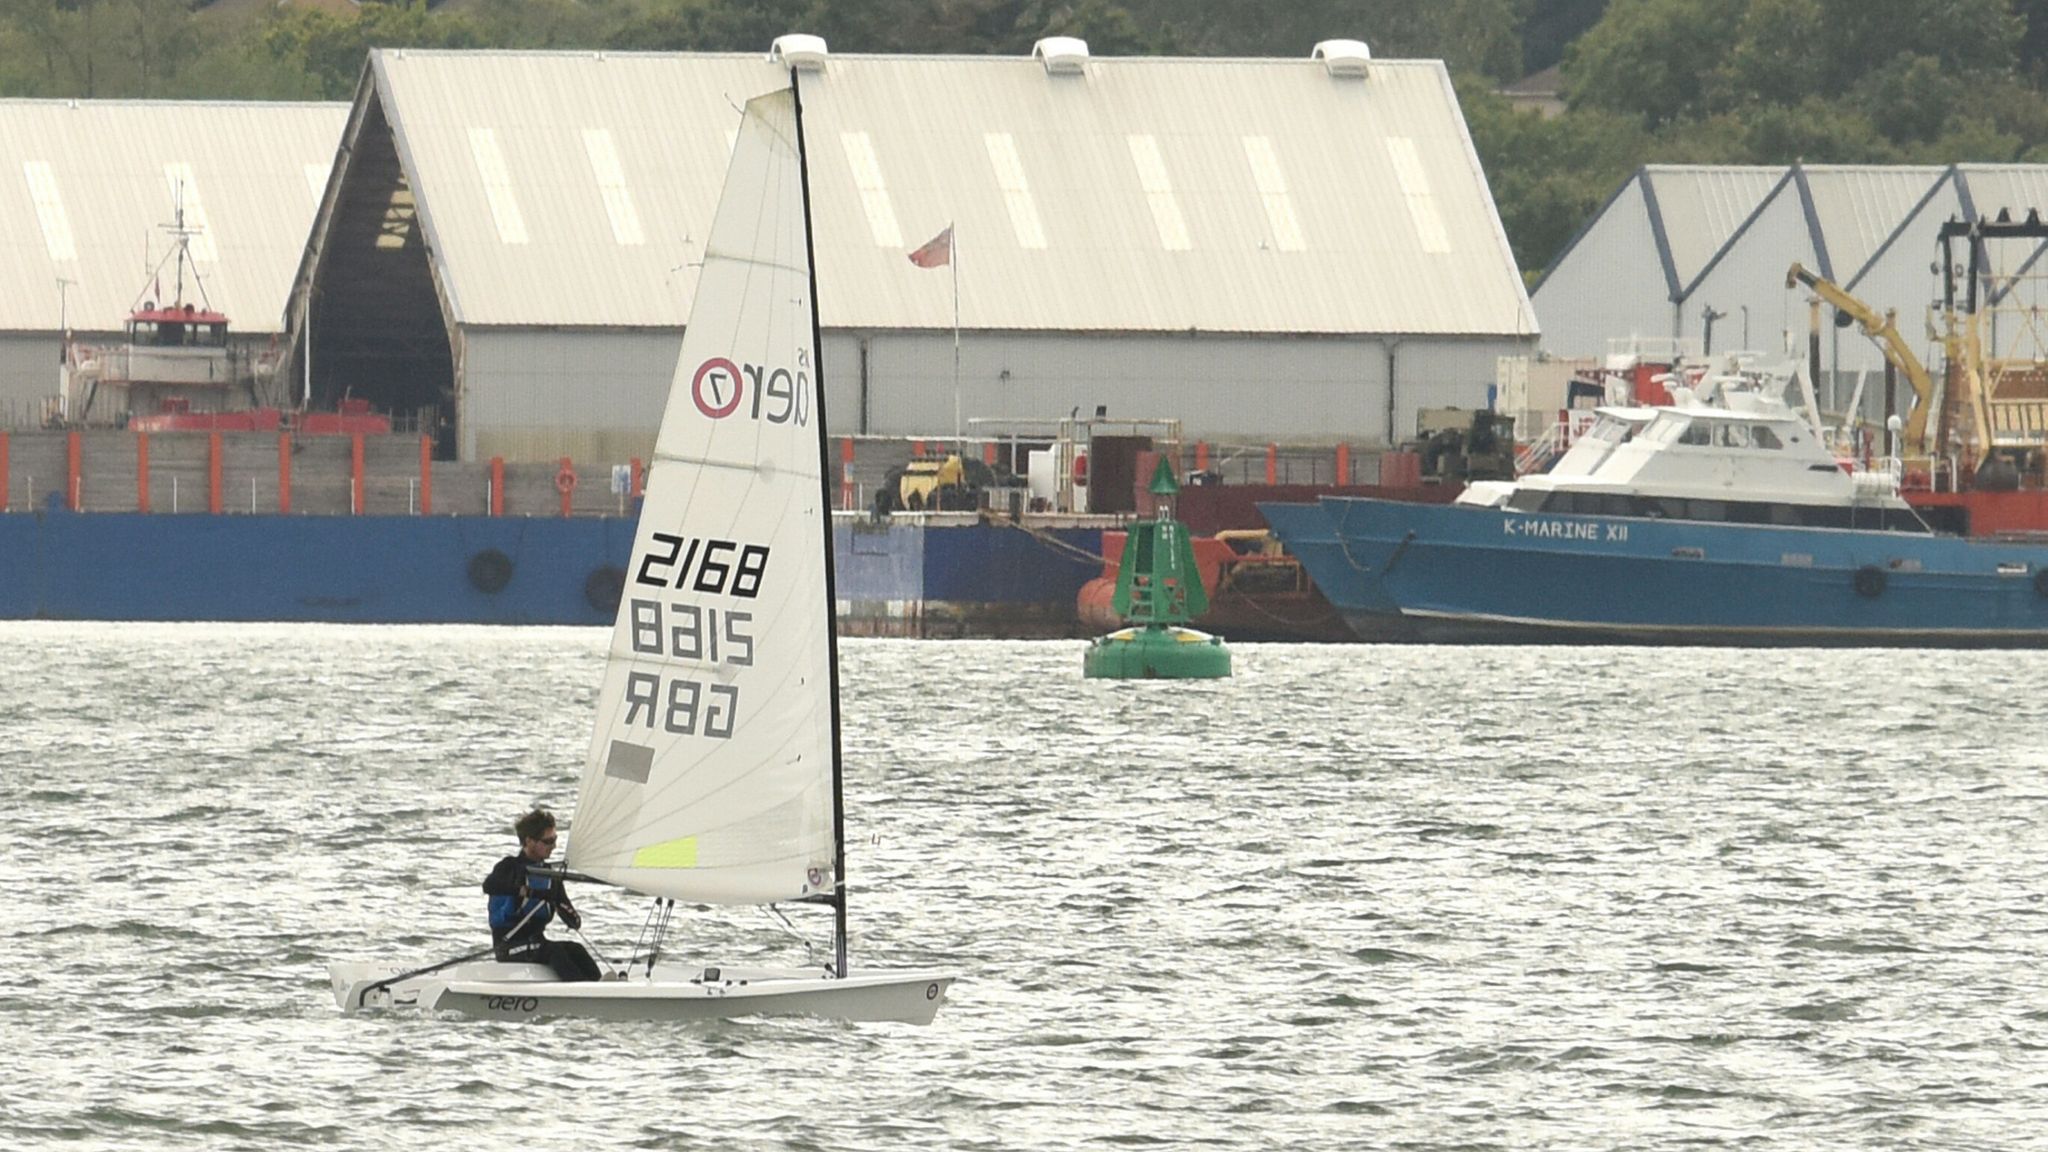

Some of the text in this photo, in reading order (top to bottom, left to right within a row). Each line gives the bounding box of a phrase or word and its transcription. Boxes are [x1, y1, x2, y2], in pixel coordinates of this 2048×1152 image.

[1606, 523, 1629, 542] XII
[636, 532, 770, 598] 2168
[488, 995, 539, 1012] aero
